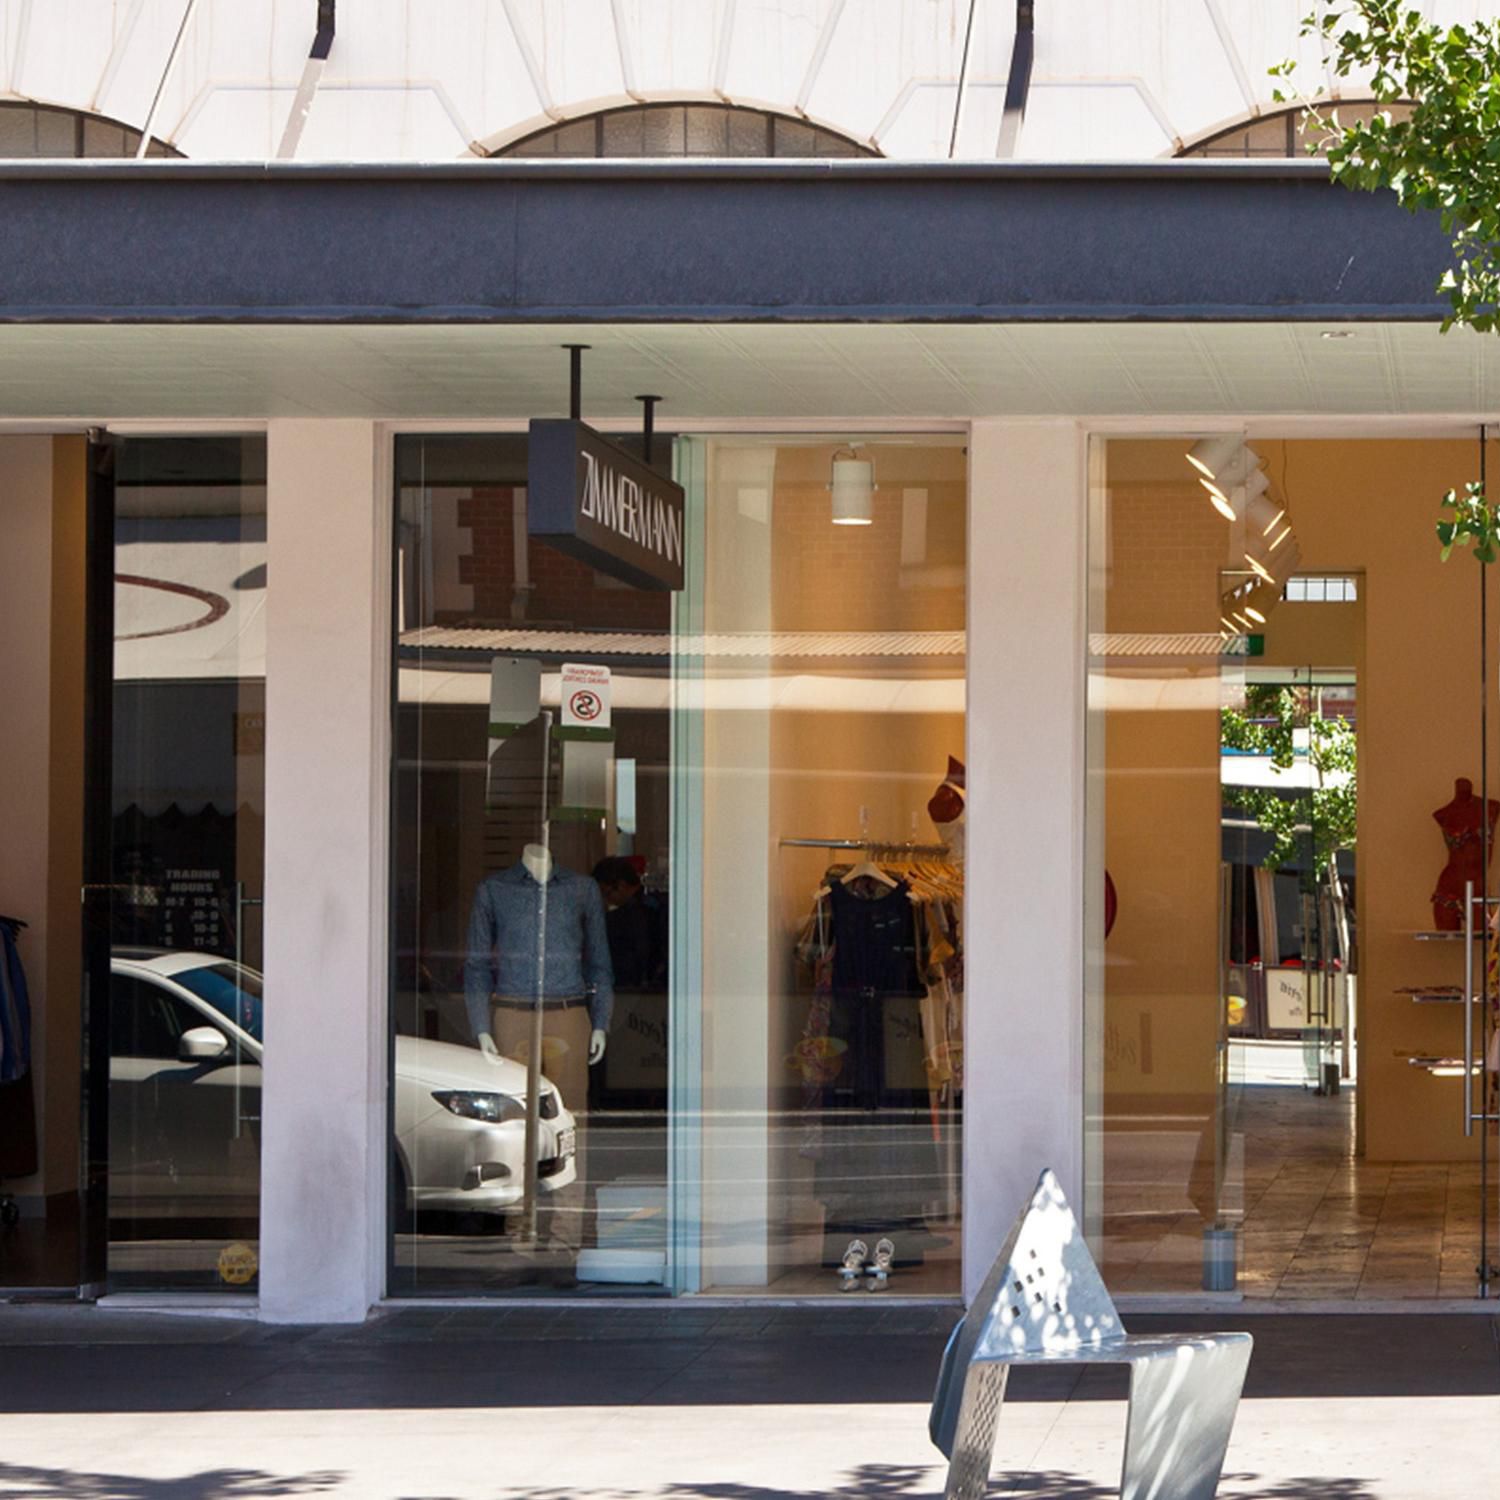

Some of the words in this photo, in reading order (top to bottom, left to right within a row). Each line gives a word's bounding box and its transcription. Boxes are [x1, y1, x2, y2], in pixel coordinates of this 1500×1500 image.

[581, 450, 682, 567] ZIMMERMANN
[165, 869, 220, 879] TRADING
[170, 882, 214, 892] HOURS
